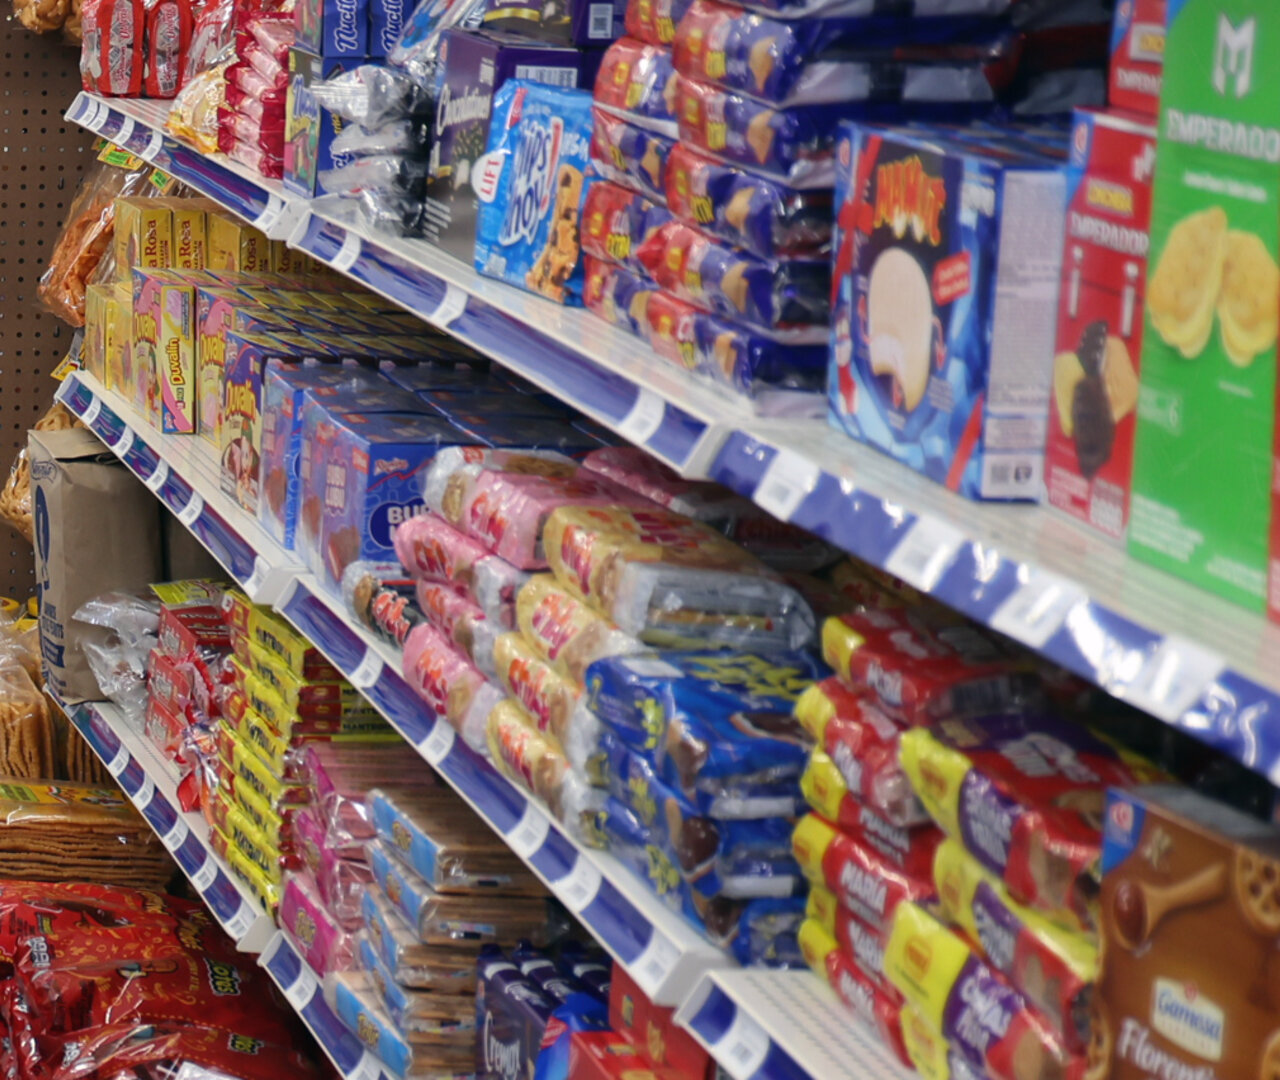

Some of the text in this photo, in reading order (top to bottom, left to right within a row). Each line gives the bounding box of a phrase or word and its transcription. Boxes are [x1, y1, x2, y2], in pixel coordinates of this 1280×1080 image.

[481, 159, 501, 195] LIFT
[144, 219, 156, 255] Rosa
[178, 219, 191, 255] Rosa
